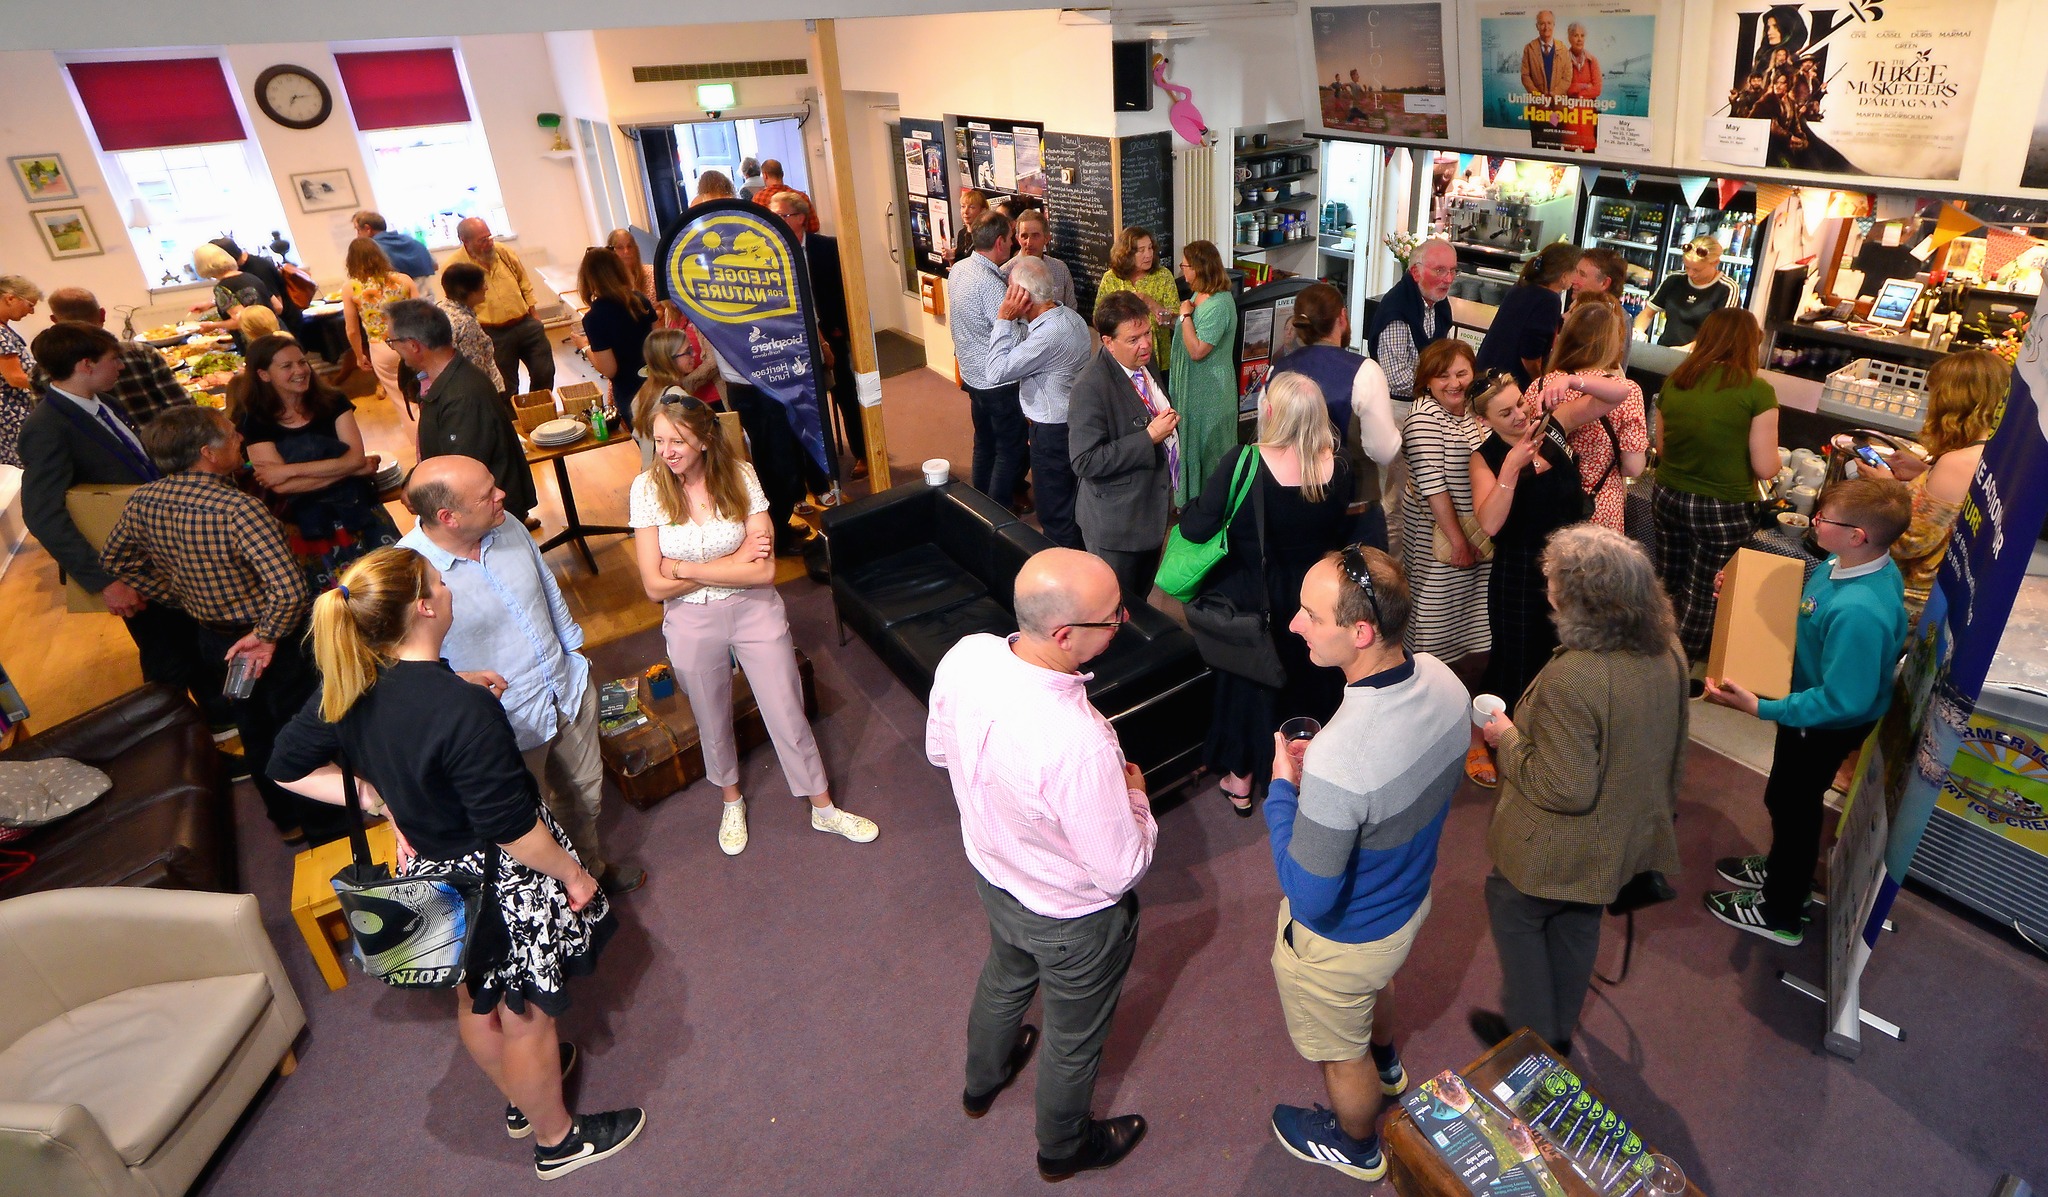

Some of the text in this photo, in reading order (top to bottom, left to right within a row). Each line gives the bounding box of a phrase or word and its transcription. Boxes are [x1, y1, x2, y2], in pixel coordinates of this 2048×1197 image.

[1367, 10, 1384, 110] CLOSE
[1867, 60, 1948, 84] THREE
[1846, 80, 1959, 98] MUSKETEERS
[1508, 92, 1617, 112] Unlikely Pilgrimage
[1523, 106, 1579, 125] Harold
[1582, 109, 1598, 125] Fr
[1975, 455, 1987, 486] KE
[1962, 493, 1982, 538] TURE
[1963, 727, 2025, 750] RMER
[1968, 801, 1999, 823] ICE
[2005, 818, 2048, 831] CRE
[389, 968, 451, 985] NLOP
[1476, 1147, 1490, 1157] Your
[1462, 1154, 1494, 1177] Nature needs
